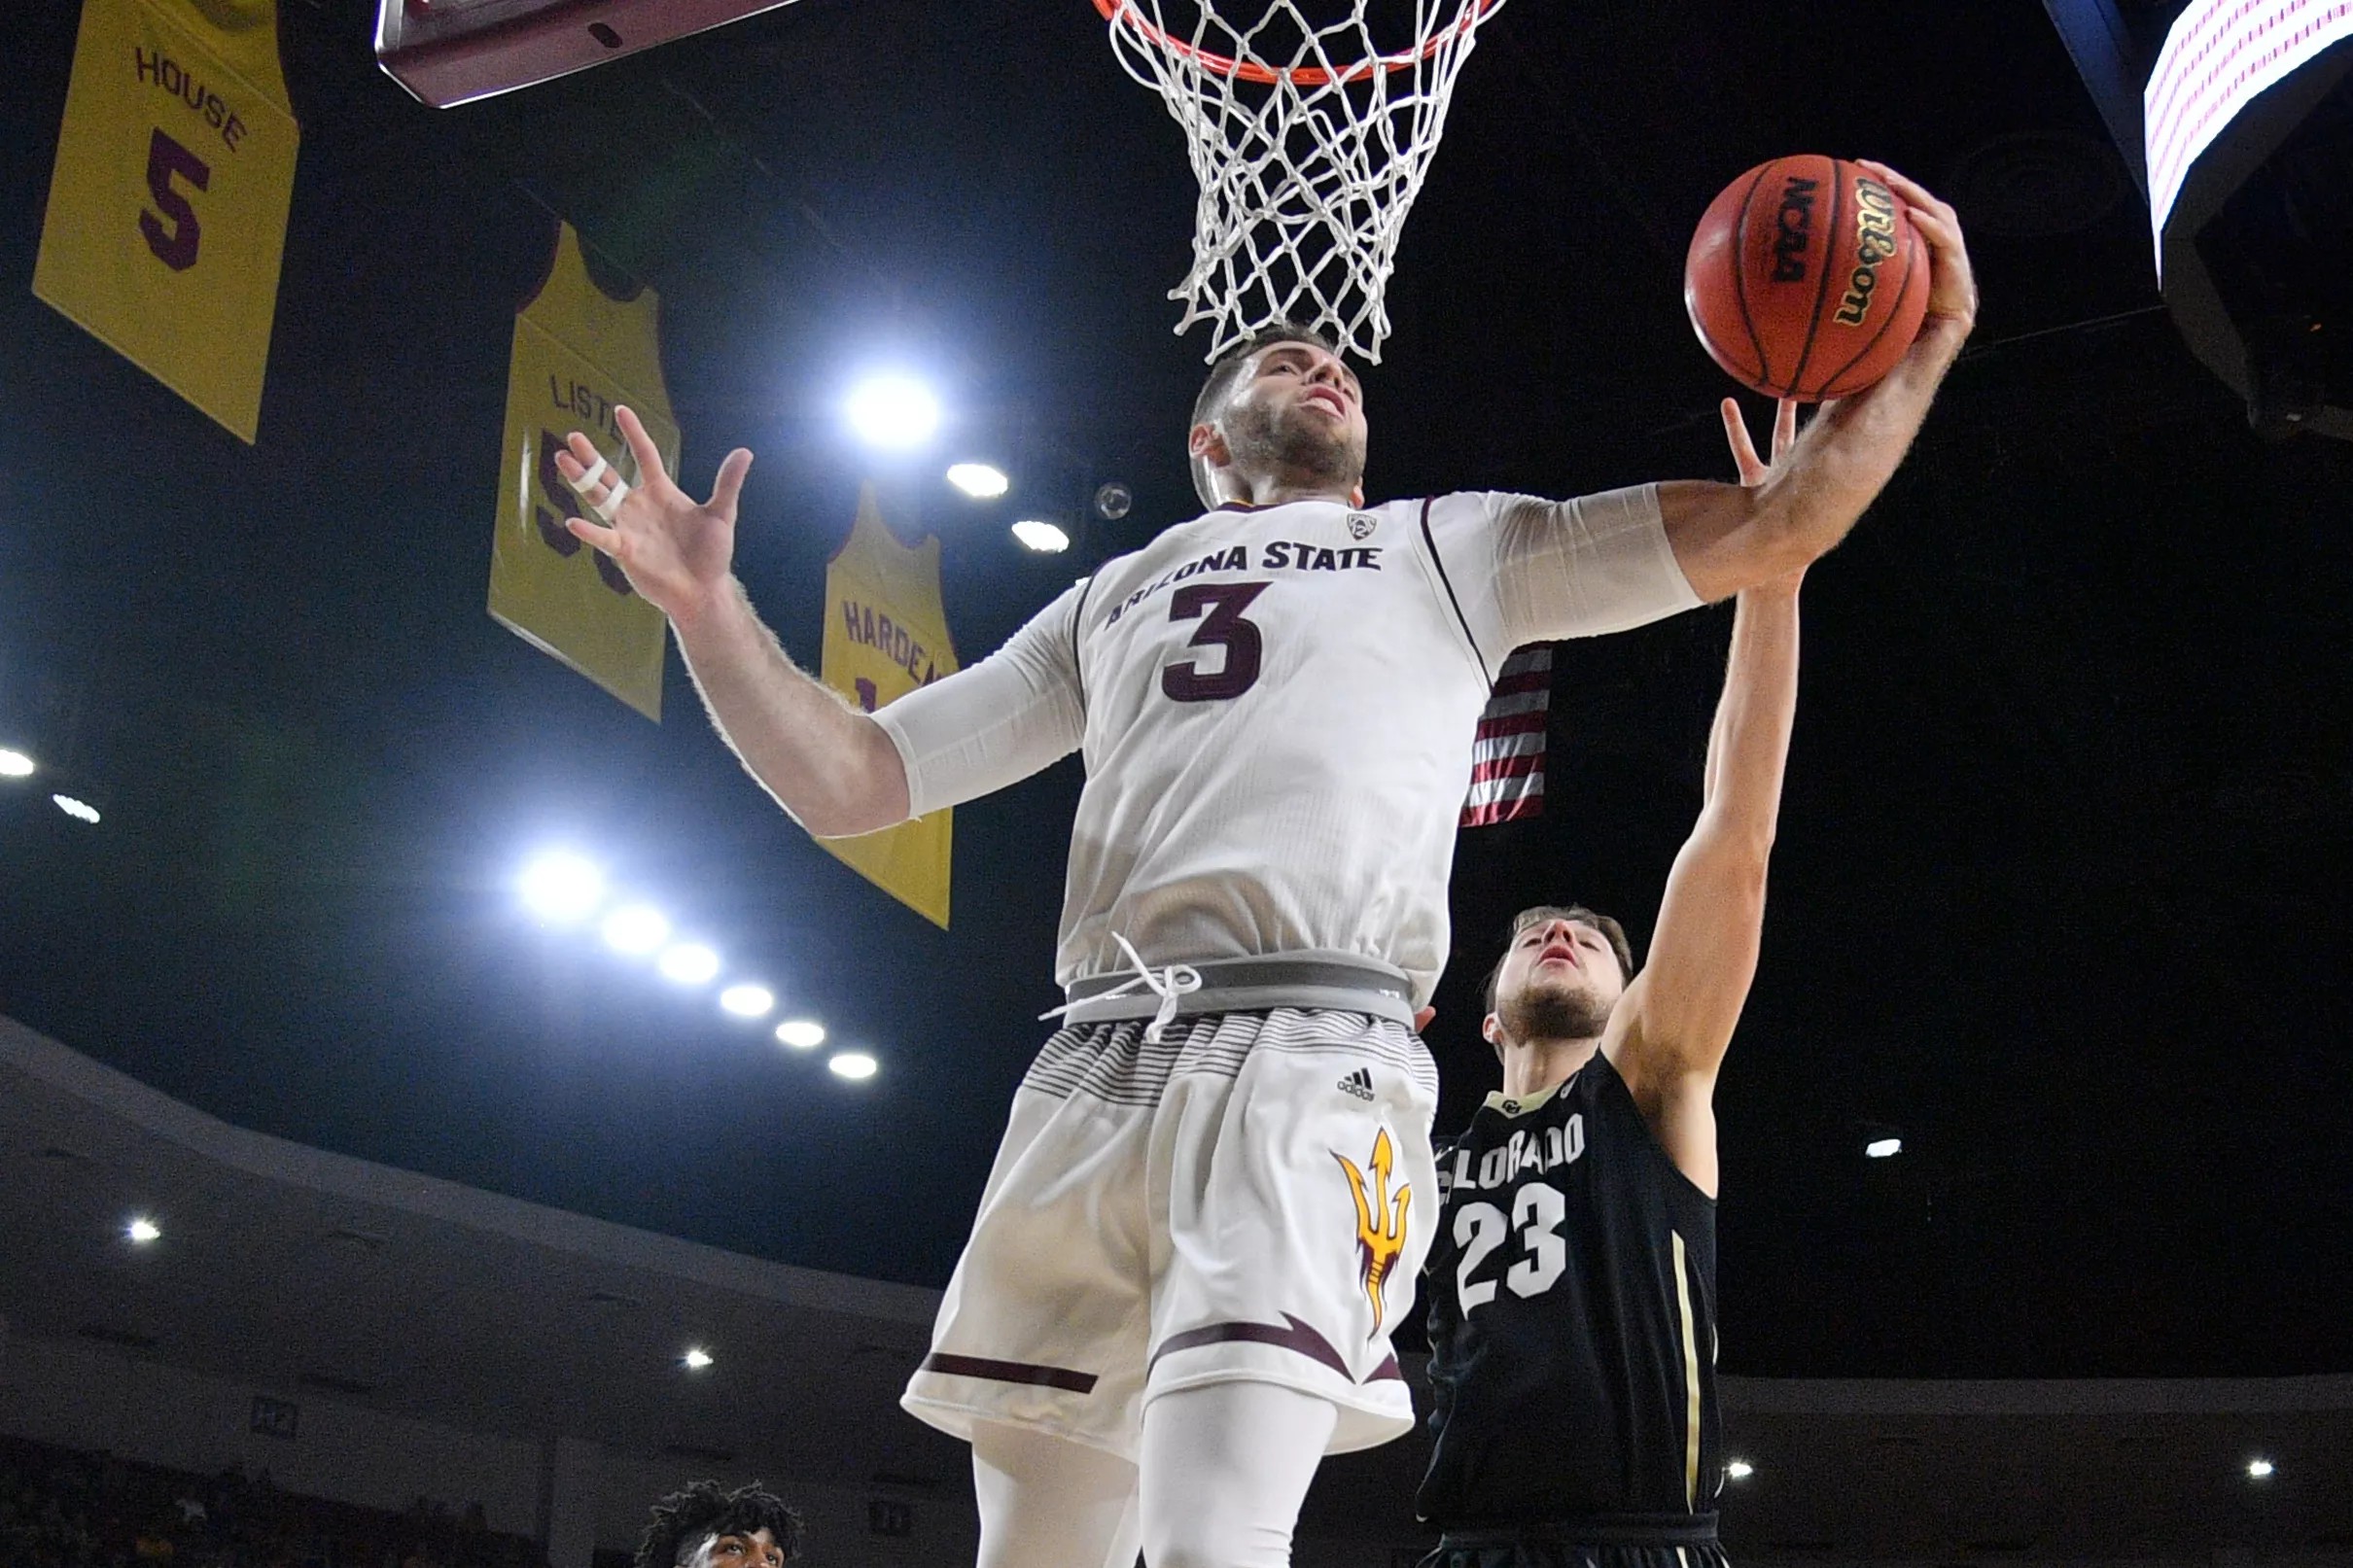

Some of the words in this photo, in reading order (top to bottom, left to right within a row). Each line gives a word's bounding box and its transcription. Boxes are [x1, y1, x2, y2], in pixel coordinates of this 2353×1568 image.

[136, 47, 248, 154] HOUSE
[139, 126, 211, 272] 5
[1774, 177, 1819, 283] NCAA
[1833, 176, 1896, 327] Wilson
[1262, 541, 1384, 572] STATE
[842, 600, 943, 687] HARDE
[1161, 581, 1275, 703] 3
[1453, 1182, 1565, 1321] 23
